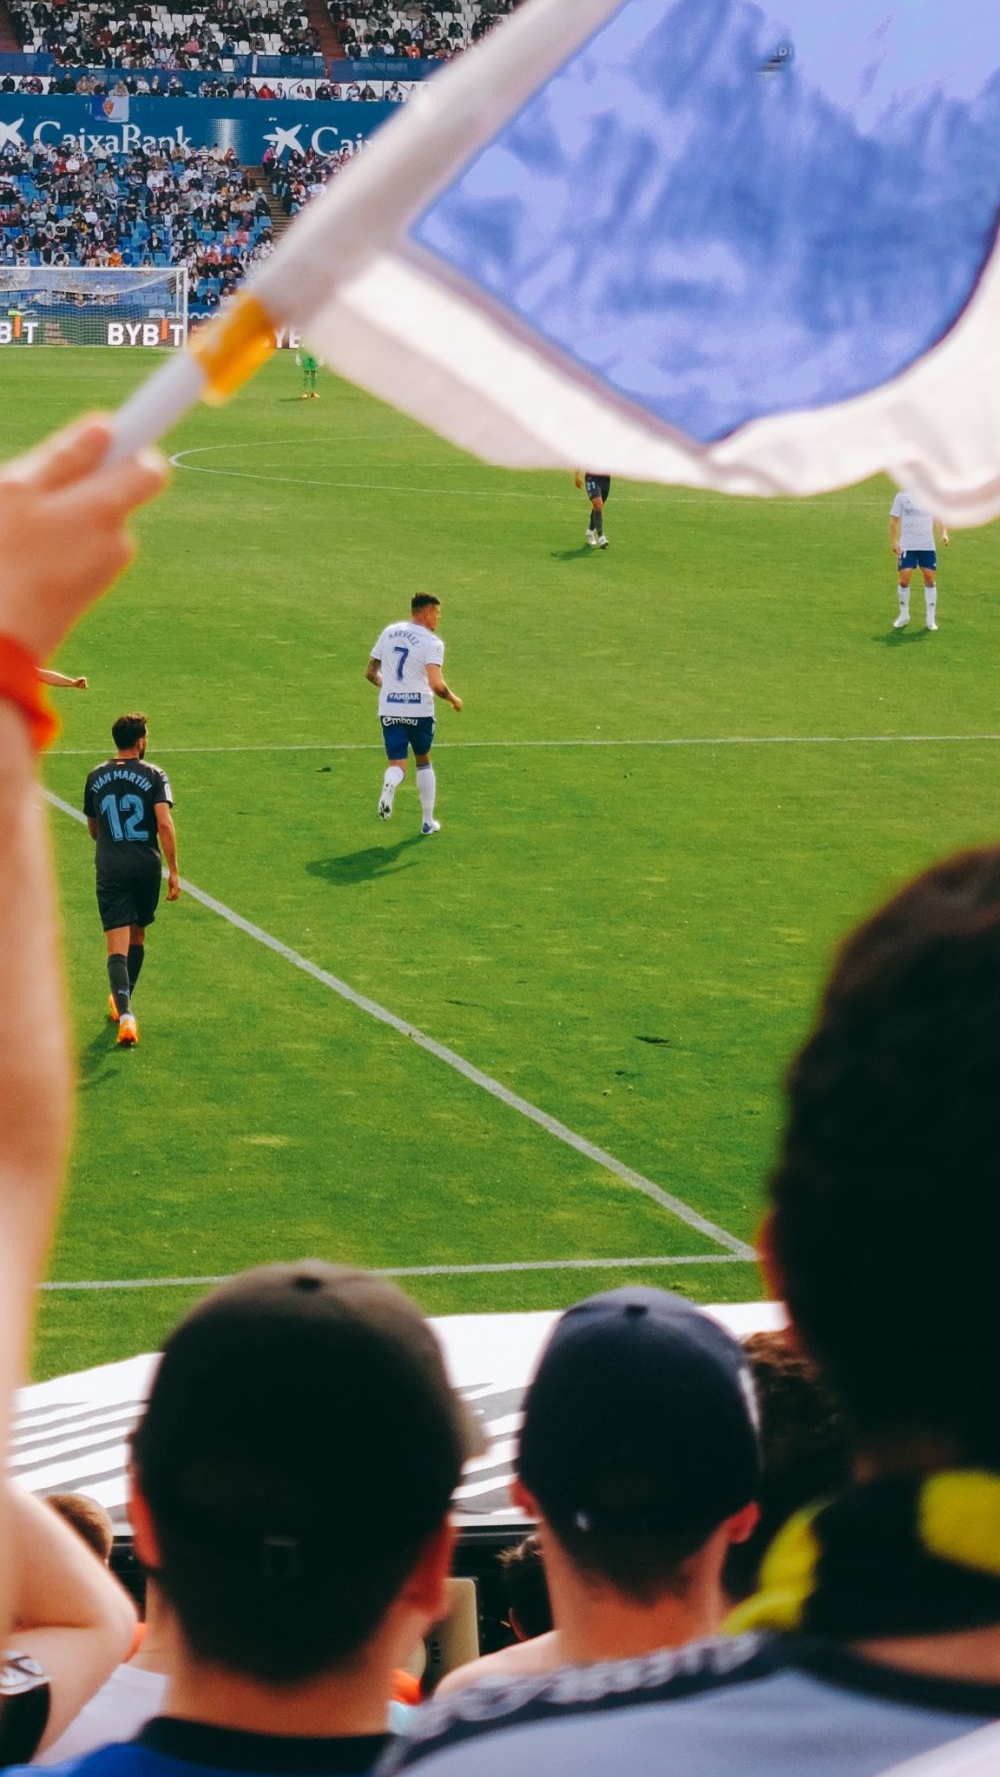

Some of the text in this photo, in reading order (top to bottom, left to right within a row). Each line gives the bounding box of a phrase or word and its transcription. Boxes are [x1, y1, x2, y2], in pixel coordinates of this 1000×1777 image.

[393, 646, 409, 681] 7
[393, 693, 420, 701] AMBAR
[382, 716, 418, 726] embou
[101, 794, 149, 841] 12
